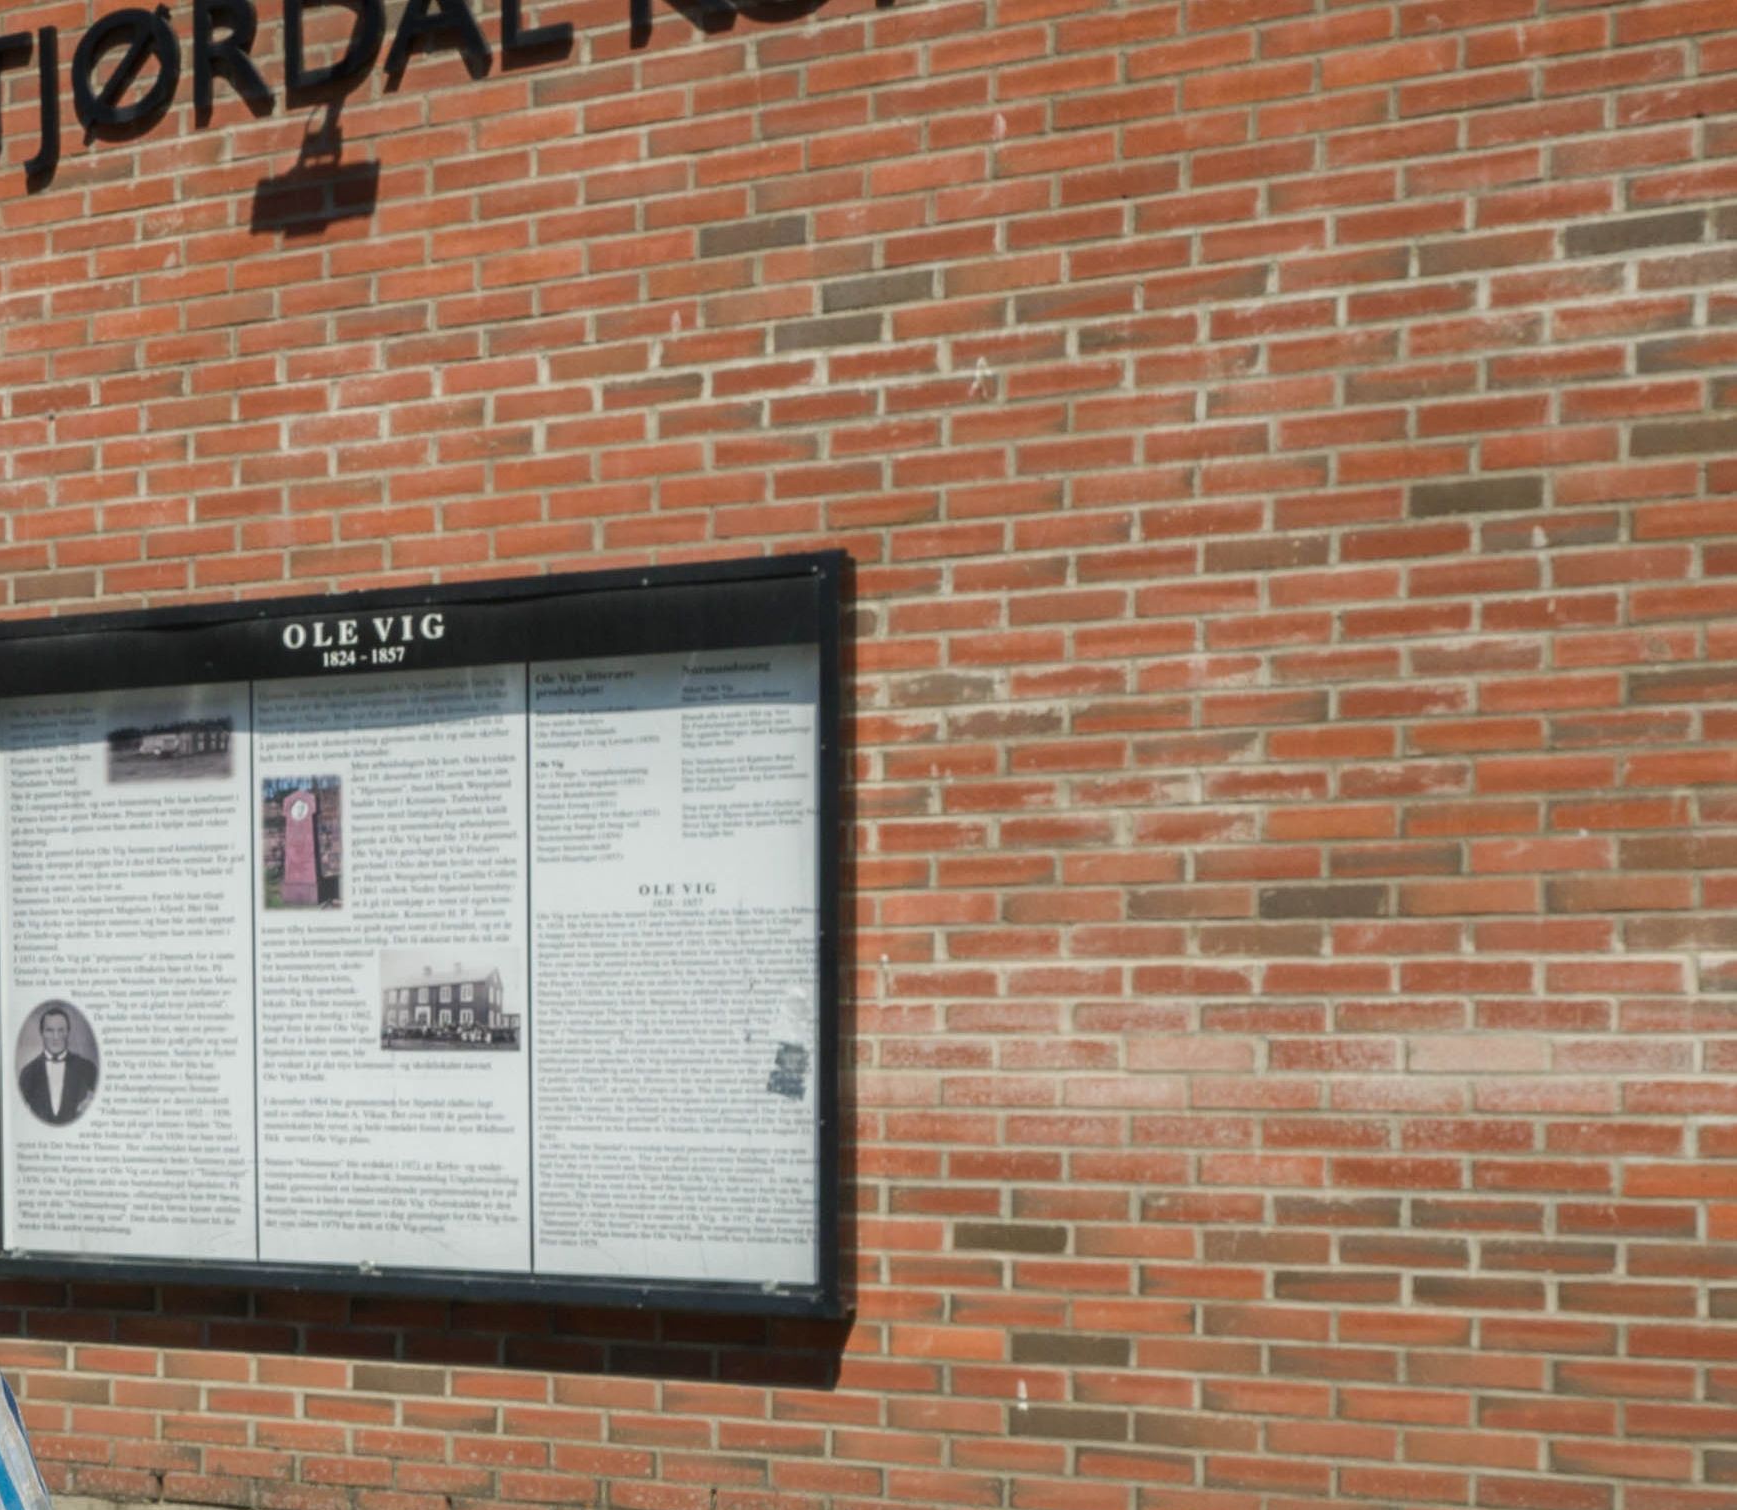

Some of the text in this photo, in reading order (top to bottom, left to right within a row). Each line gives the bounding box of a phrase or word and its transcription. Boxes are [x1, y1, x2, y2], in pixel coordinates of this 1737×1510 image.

[282, 613, 446, 649] OLE VIG
[323, 650, 356, 667] 1824
[371, 646, 406, 664] 1857
[638, 882, 718, 896] OLE VIG
